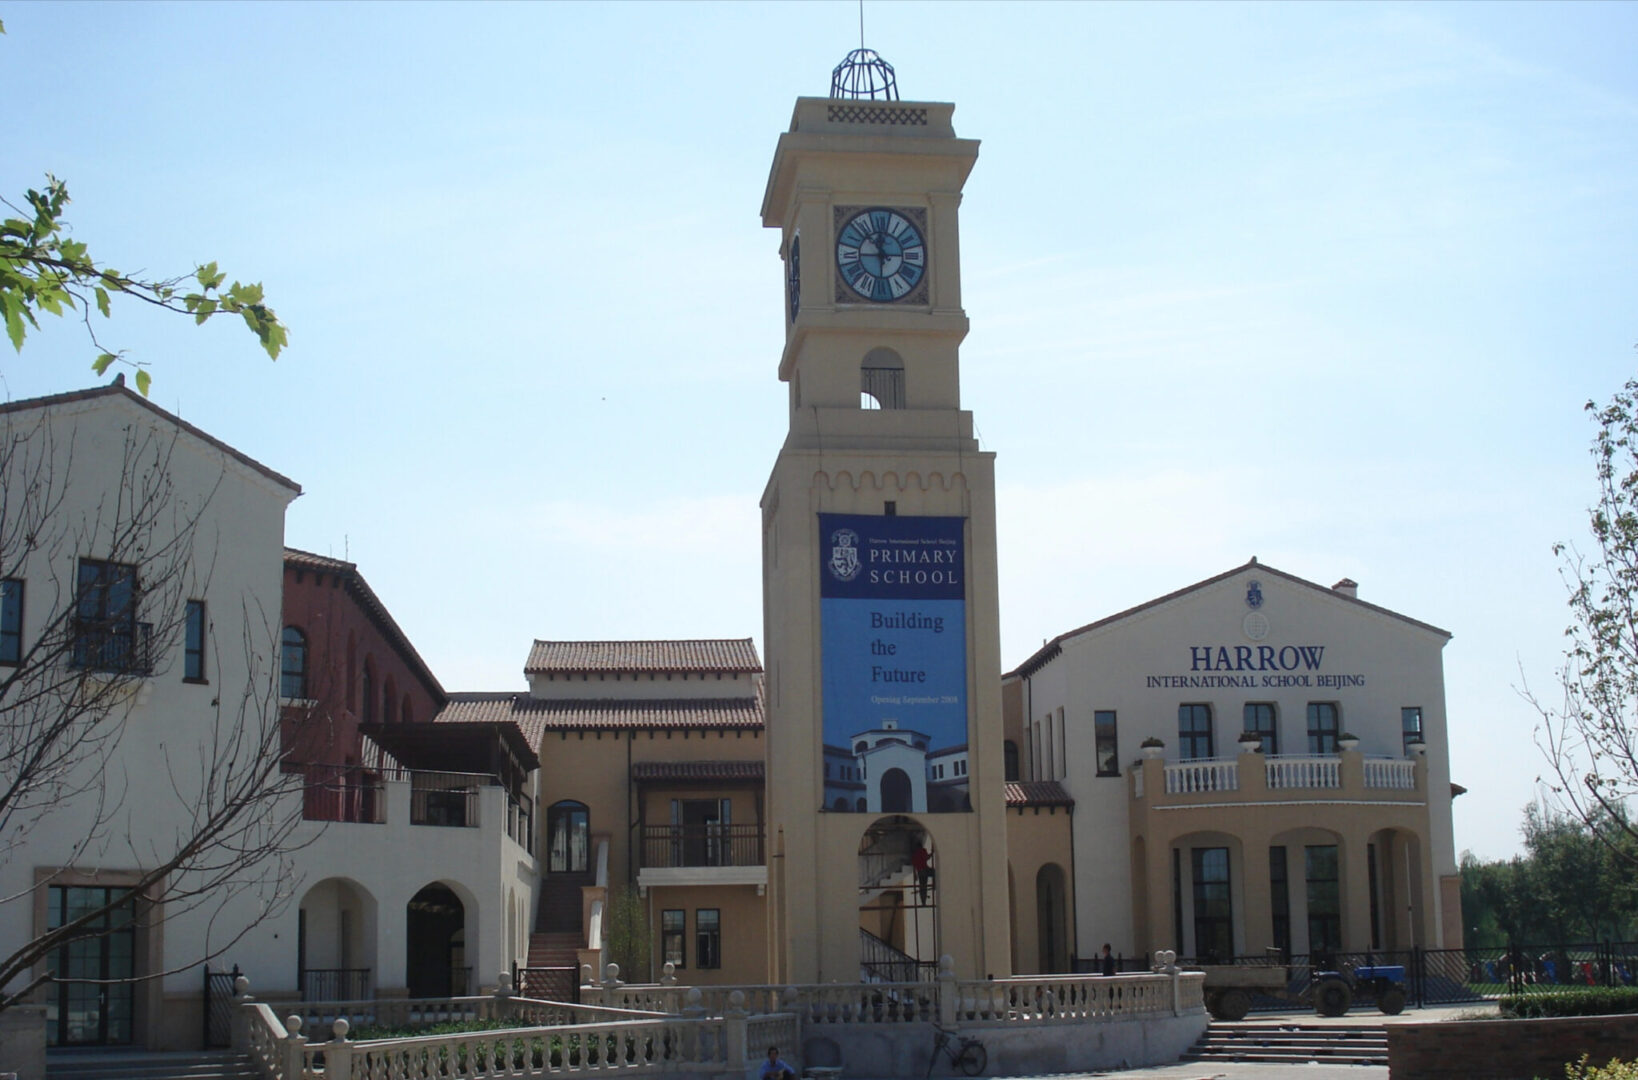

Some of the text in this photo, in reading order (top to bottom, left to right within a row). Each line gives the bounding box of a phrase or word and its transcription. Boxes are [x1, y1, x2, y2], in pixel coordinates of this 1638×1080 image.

[870, 549, 957, 563] PRIMARY
[870, 569, 958, 584] SCHOOL
[871, 612, 944, 632] Building
[871, 639, 896, 656] the
[1190, 646, 1325, 671] HARROW
[871, 666, 926, 683] Future
[1146, 674, 1365, 690] INTERNATIONAL SCHOOL BEIJING
[870, 695, 901, 705] Opening
[902, 695, 939, 705] September
